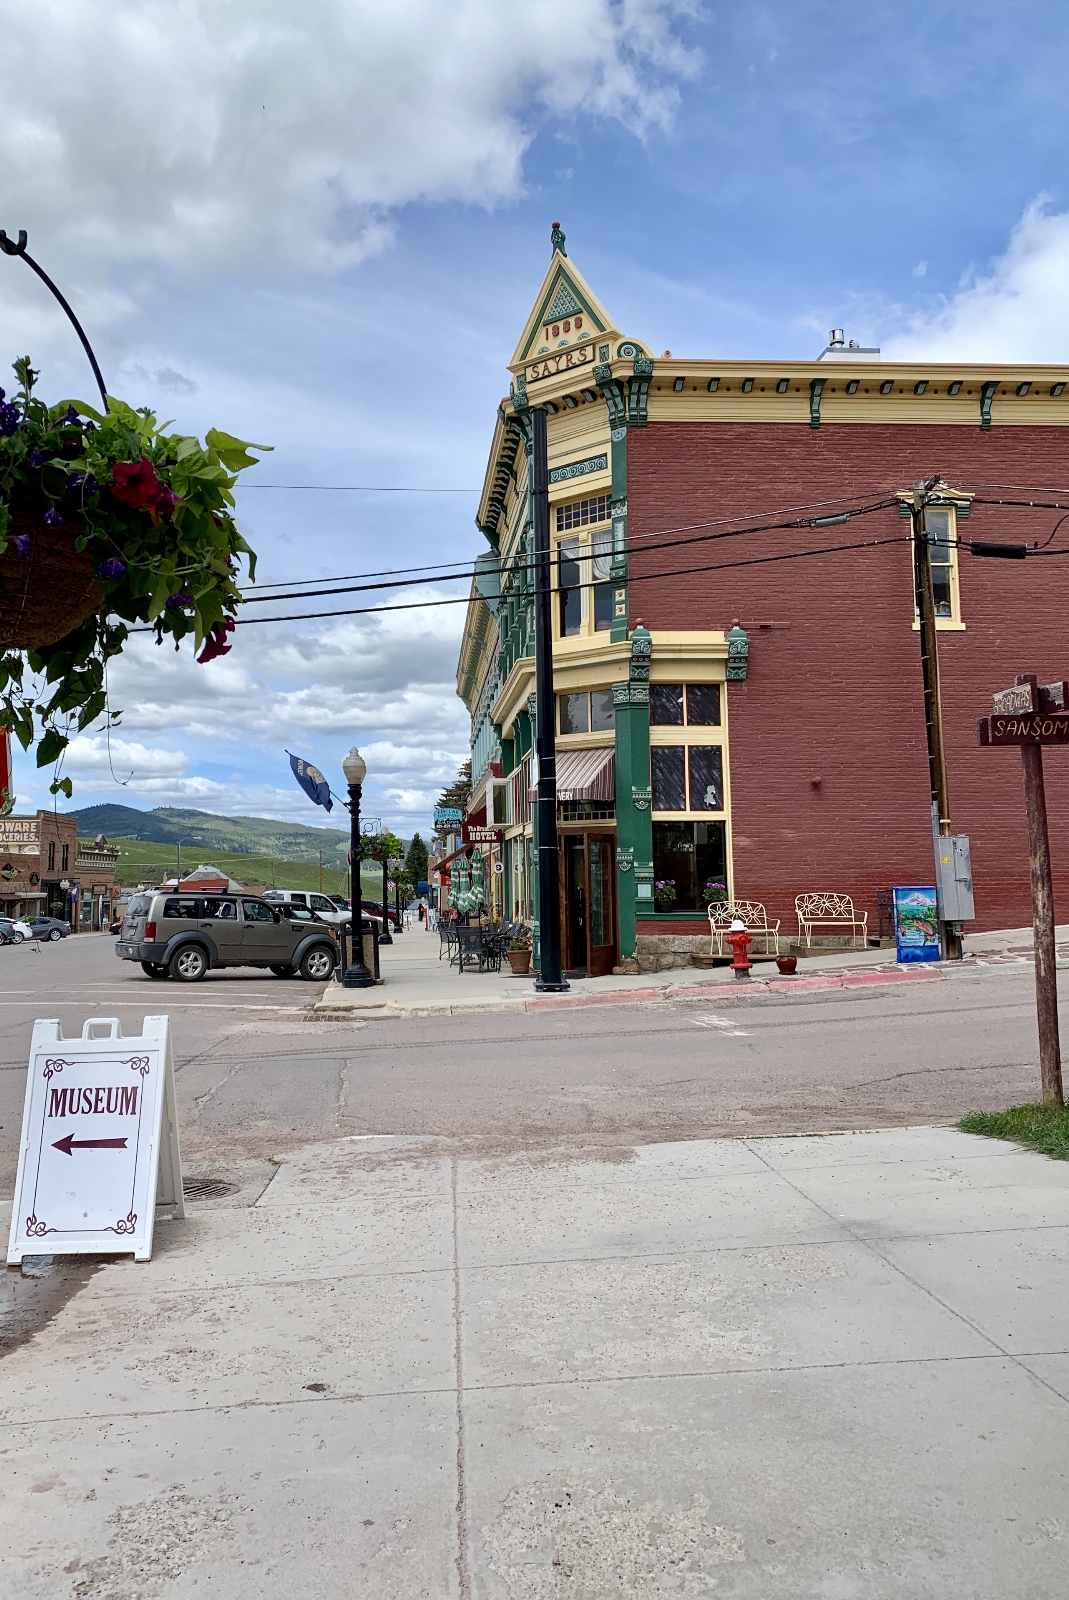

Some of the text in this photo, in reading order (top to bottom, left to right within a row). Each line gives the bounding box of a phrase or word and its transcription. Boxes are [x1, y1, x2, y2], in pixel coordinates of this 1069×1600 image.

[545, 316, 583, 341] 1888
[530, 348, 588, 379] SAYRS
[995, 720, 1069, 737] SANSOM
[470, 832, 496, 840] HOTEL
[48, 1086, 139, 1117] MUSEUM
